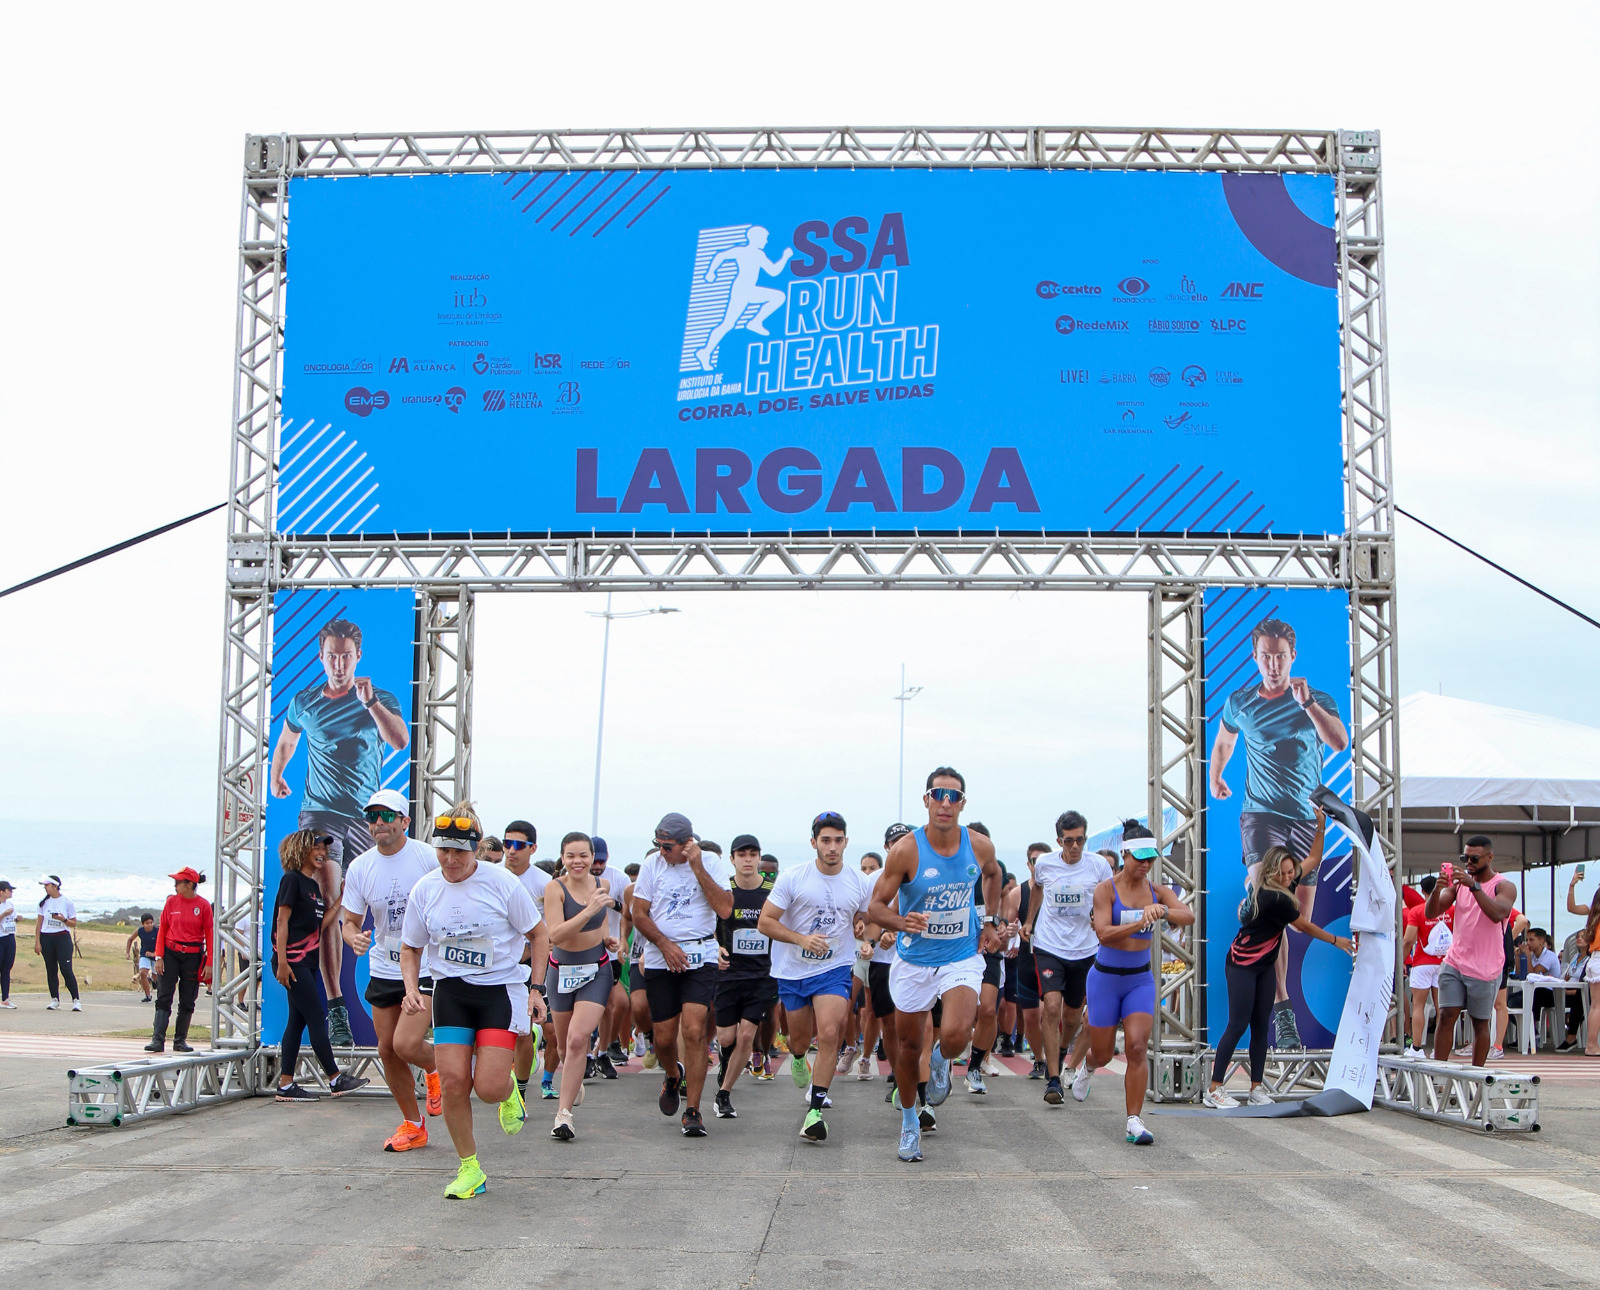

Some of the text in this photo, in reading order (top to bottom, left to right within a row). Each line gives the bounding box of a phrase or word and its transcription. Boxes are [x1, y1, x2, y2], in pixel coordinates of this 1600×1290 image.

[790, 212, 910, 278] SSA
[455, 288, 487, 308] iub
[1191, 293, 1208, 301] ello
[784, 270, 899, 337] RUN
[475, 312, 502, 320] Urologia
[1148, 320, 1200, 331] FÁBIO SOUTO
[490, 361, 512, 369] Cárdio
[581, 361, 604, 369] REDE
[743, 324, 939, 397] HEALTH
[304, 364, 351, 373] ONCOLOGIA
[414, 364, 455, 372] ALIANÇA
[679, 373, 725, 390] INSTITUTO DE
[1061, 370, 1088, 383] LIVE!
[1112, 373, 1136, 383] BARRA
[677, 381, 741, 401] UROLOGIA DA BAHIA
[349, 396, 385, 405] EMS
[510, 392, 538, 402] SANTA
[678, 383, 934, 421] CORRA, DOE, SALVE VIDAS
[510, 399, 542, 408] HELENA
[1184, 424, 1217, 432] SMILE
[576, 447, 1041, 514] LARGADA
[1056, 894, 1078, 903] 0136
[930, 924, 961, 934] 0402
[740, 940, 763, 950] 0572
[448, 948, 483, 966] 0614
[688, 954, 700, 964] 81
